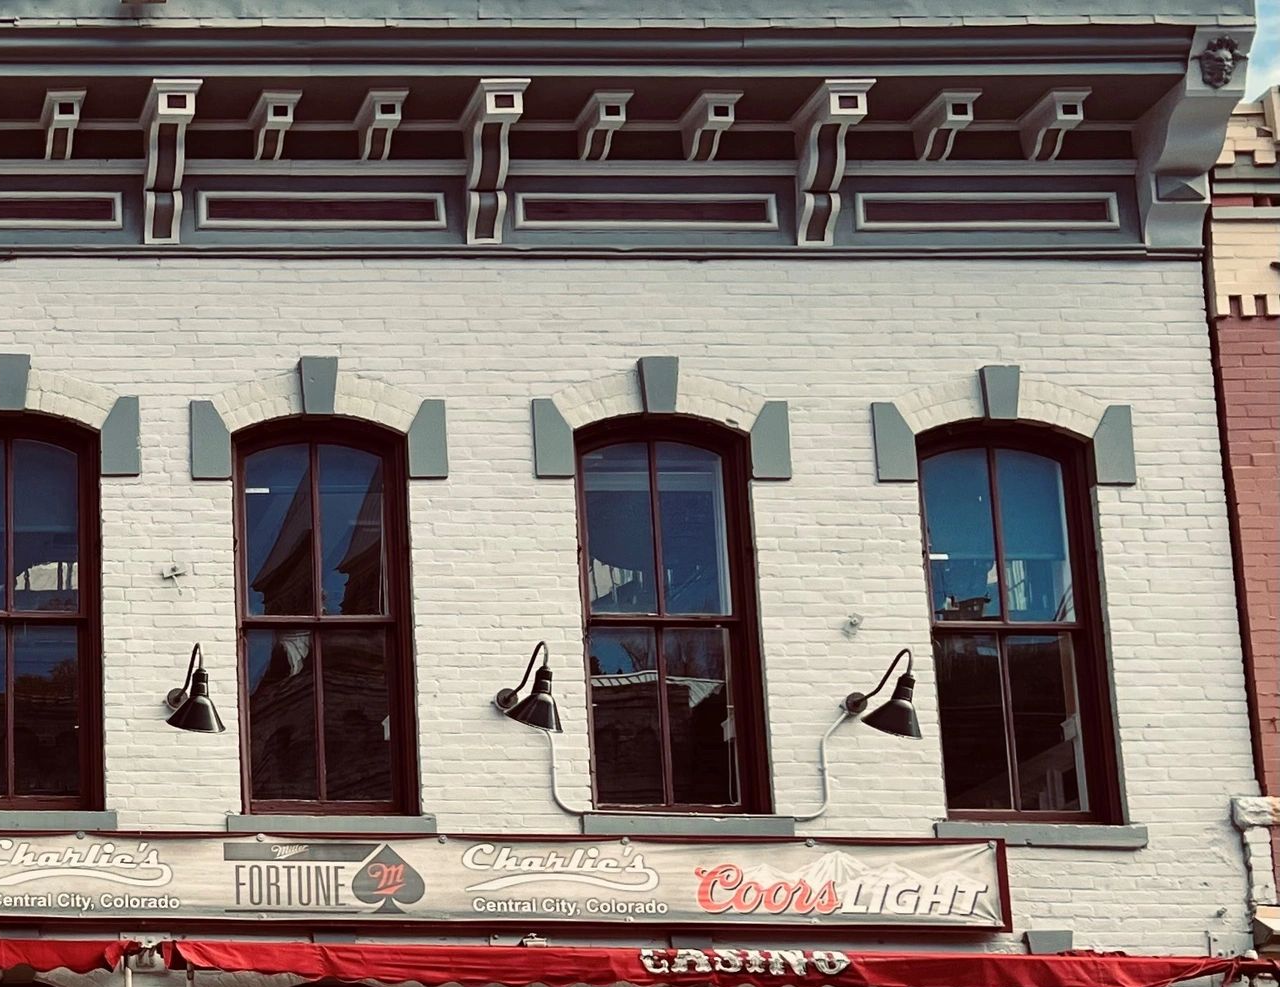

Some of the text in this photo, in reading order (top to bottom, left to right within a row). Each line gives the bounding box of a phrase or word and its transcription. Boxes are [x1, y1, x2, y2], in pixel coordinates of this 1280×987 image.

[271, 843, 310, 860] Miller
[461, 842, 652, 879] Charlie's
[235, 864, 346, 907] FORTUNE
[695, 863, 990, 917] Coors LIGHT
[56, 892, 96, 911] City,
[99, 893, 181, 910] Colorado
[472, 897, 669, 916] Central City, Colorado
[640, 947, 851, 976] CASINO
